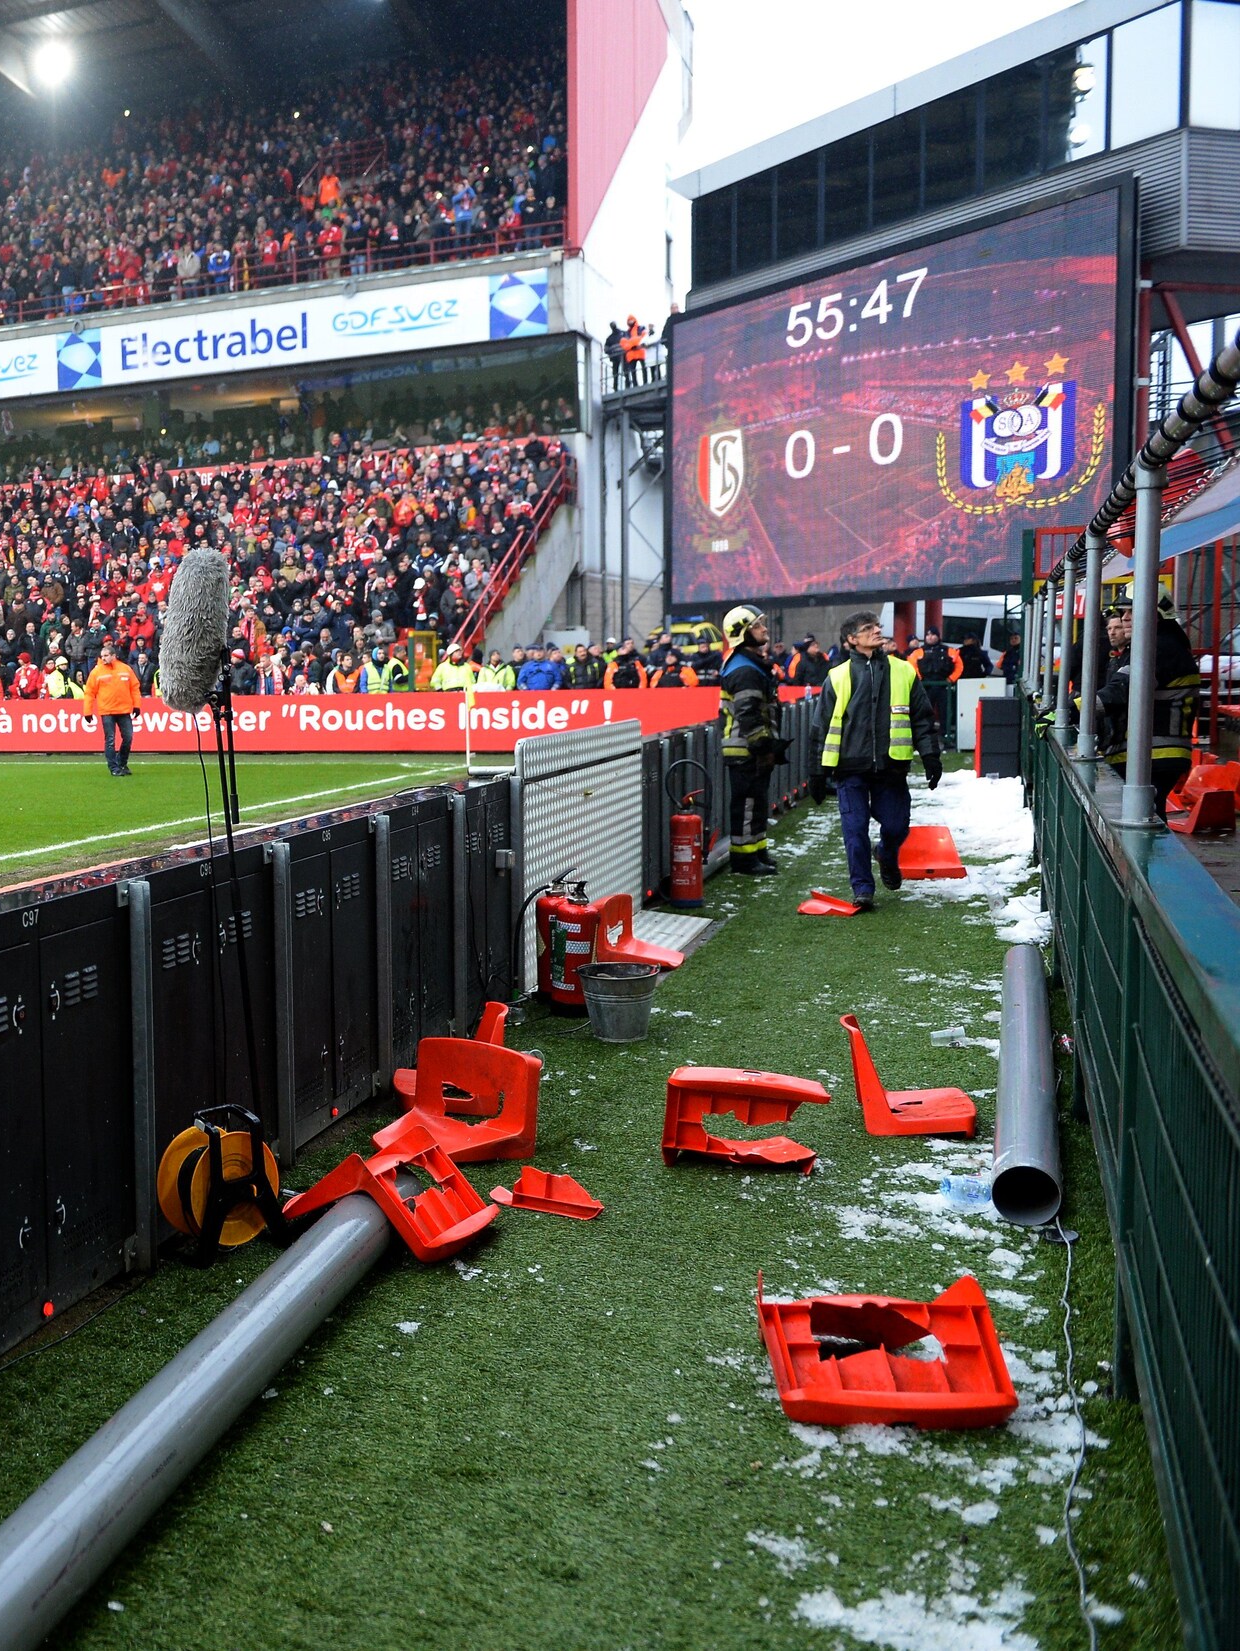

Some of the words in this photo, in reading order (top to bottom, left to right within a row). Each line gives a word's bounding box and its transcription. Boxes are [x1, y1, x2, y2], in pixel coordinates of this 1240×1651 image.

[786, 267, 928, 348] 55:47
[120, 312, 308, 371] Electrabel
[785, 430, 815, 479] 0
[869, 413, 904, 465] 0
[22, 709, 98, 733] notre
[281, 702, 445, 731] "Rouches
[458, 700, 589, 730] Inside"
[22, 909, 40, 928] C97
